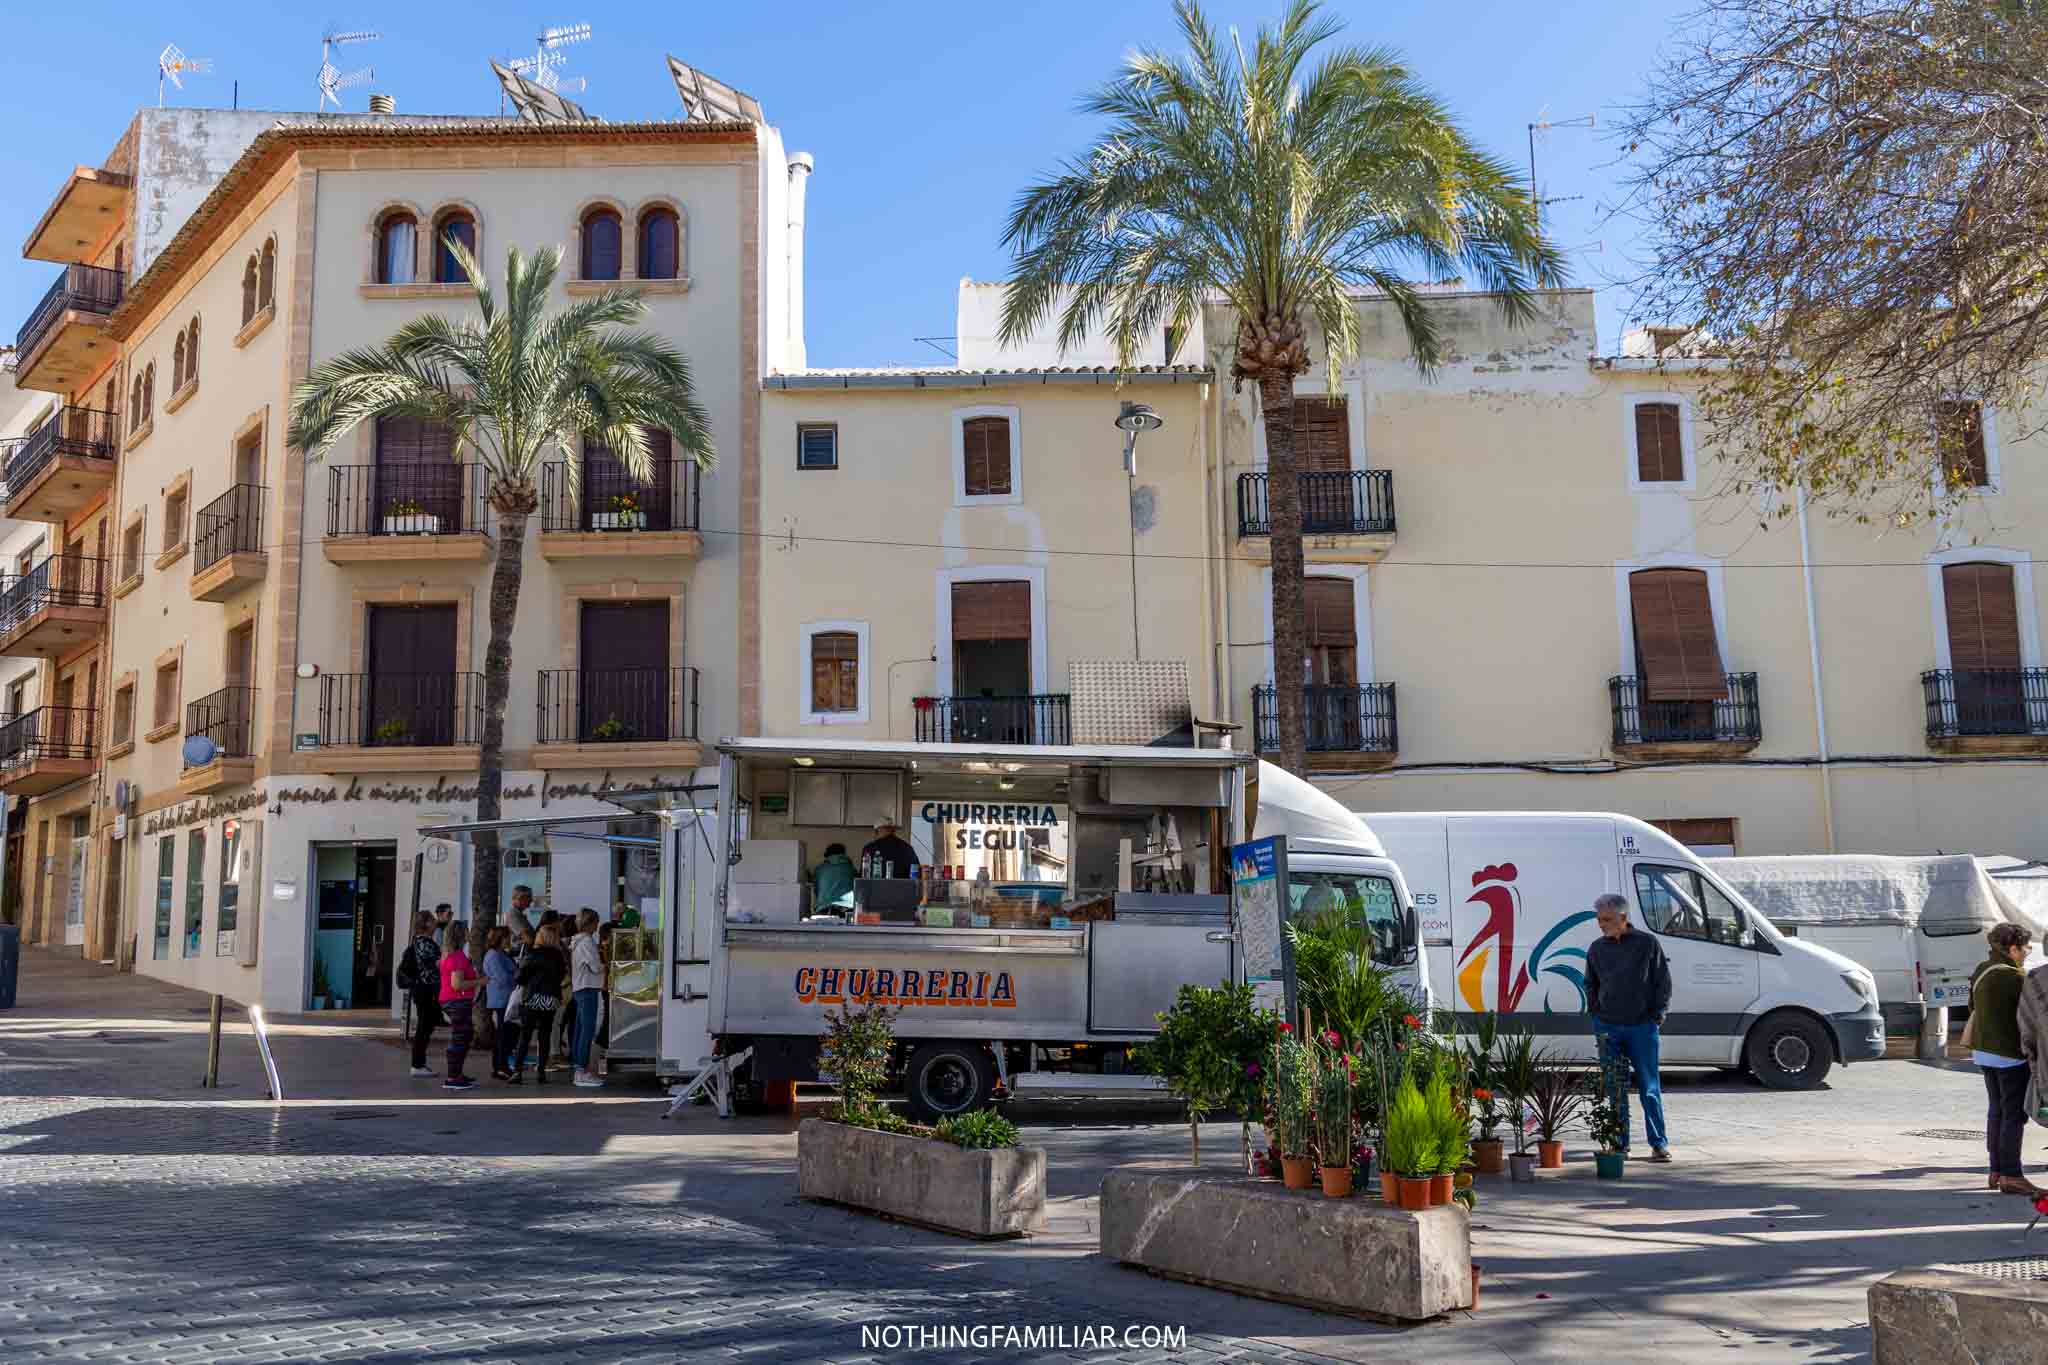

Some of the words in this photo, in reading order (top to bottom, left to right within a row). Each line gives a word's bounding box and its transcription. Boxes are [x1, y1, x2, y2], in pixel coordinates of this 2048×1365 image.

[344, 775, 362, 801] de
[921, 802, 1058, 826] CHURRERIA
[956, 829, 1025, 850] SEGUI
[794, 967, 1016, 1007] CHURRERIA
